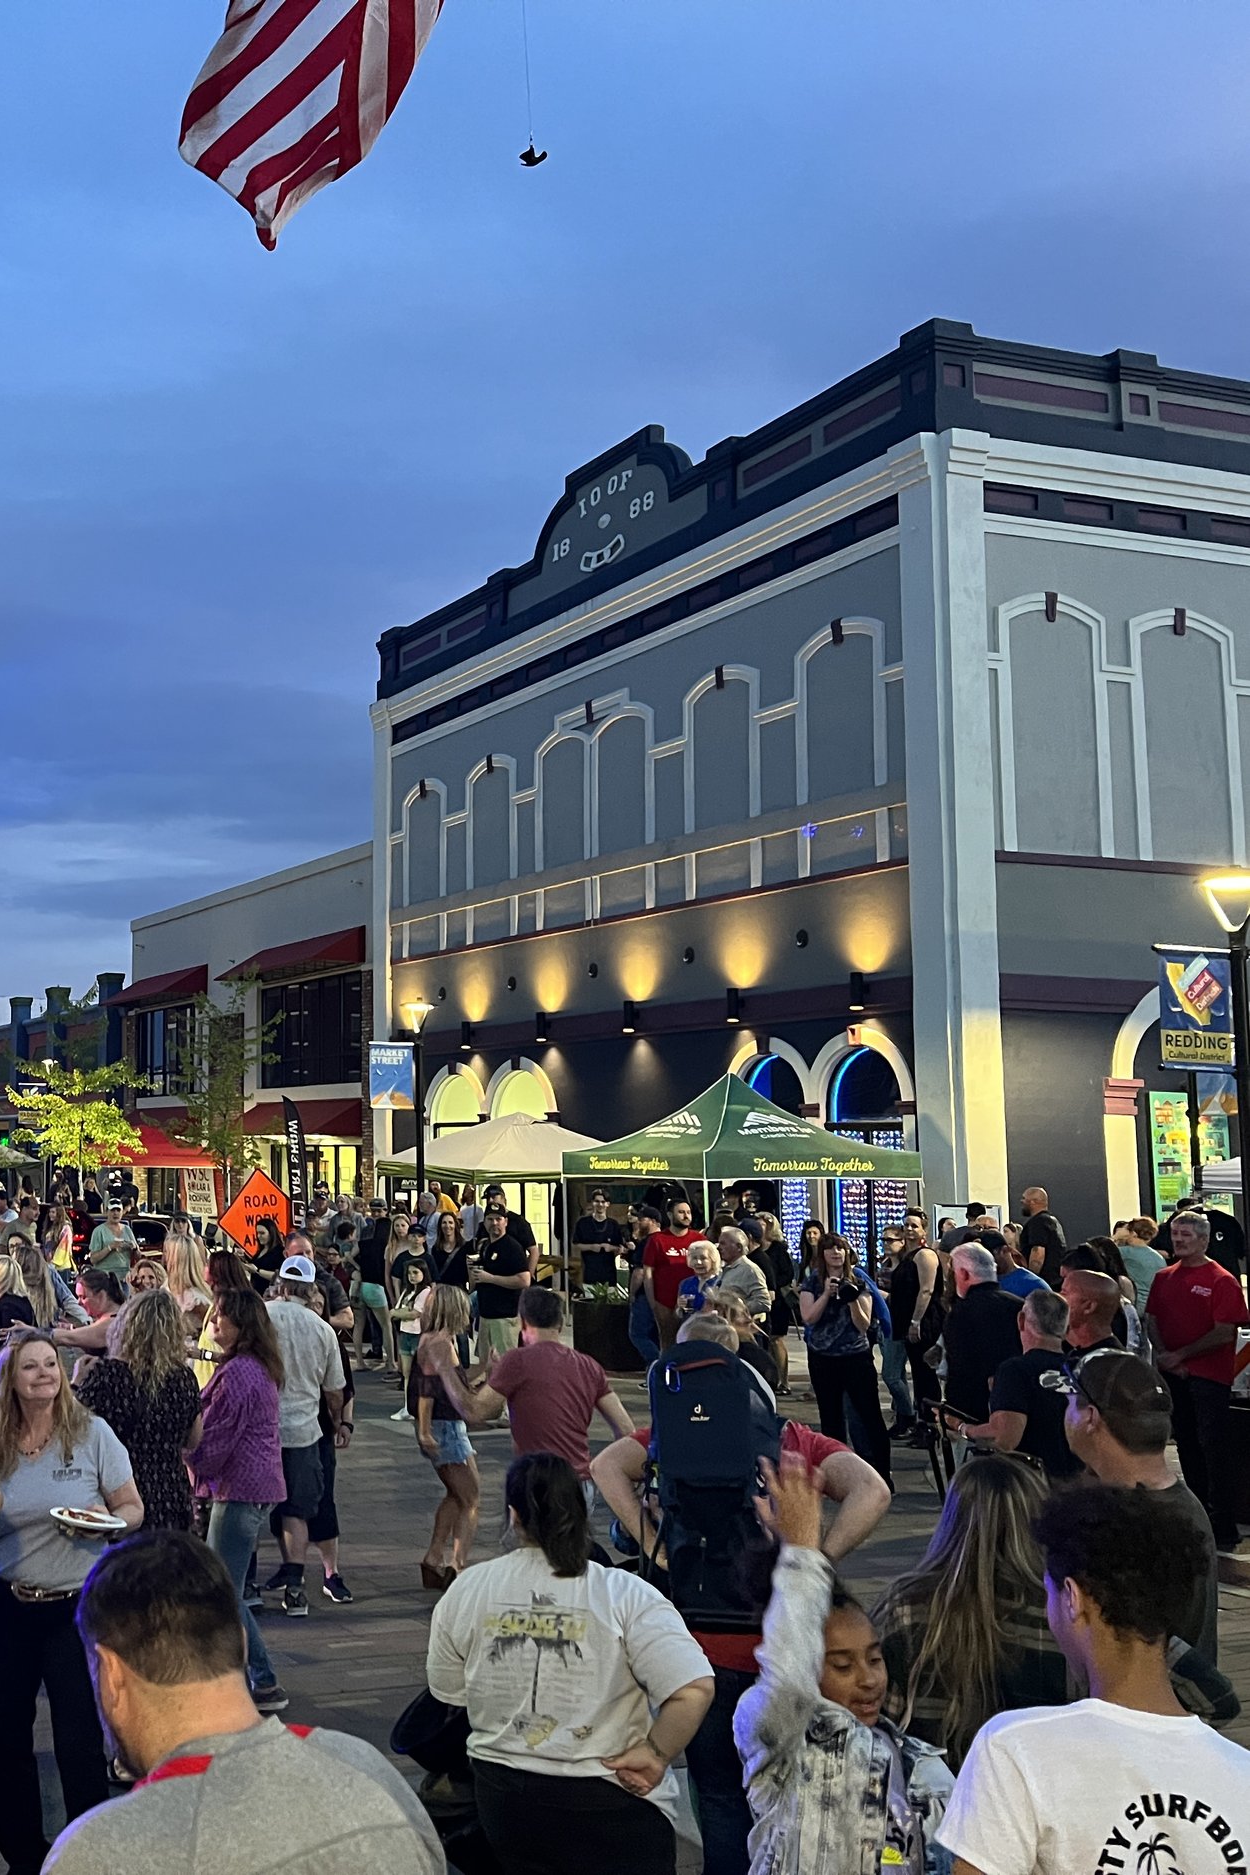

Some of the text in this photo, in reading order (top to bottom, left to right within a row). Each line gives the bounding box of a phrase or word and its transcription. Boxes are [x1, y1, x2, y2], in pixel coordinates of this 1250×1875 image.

[1165, 1034, 1228, 1051] REDDING
[371, 1048, 410, 1058] MARKET
[371, 1056, 405, 1065] STREET
[1169, 1050, 1226, 1061] Cultural District
[589, 1155, 670, 1175] Tomorrow Together
[753, 1156, 876, 1176] Tomorrow Together
[244, 1194, 277, 1209] ROAD
